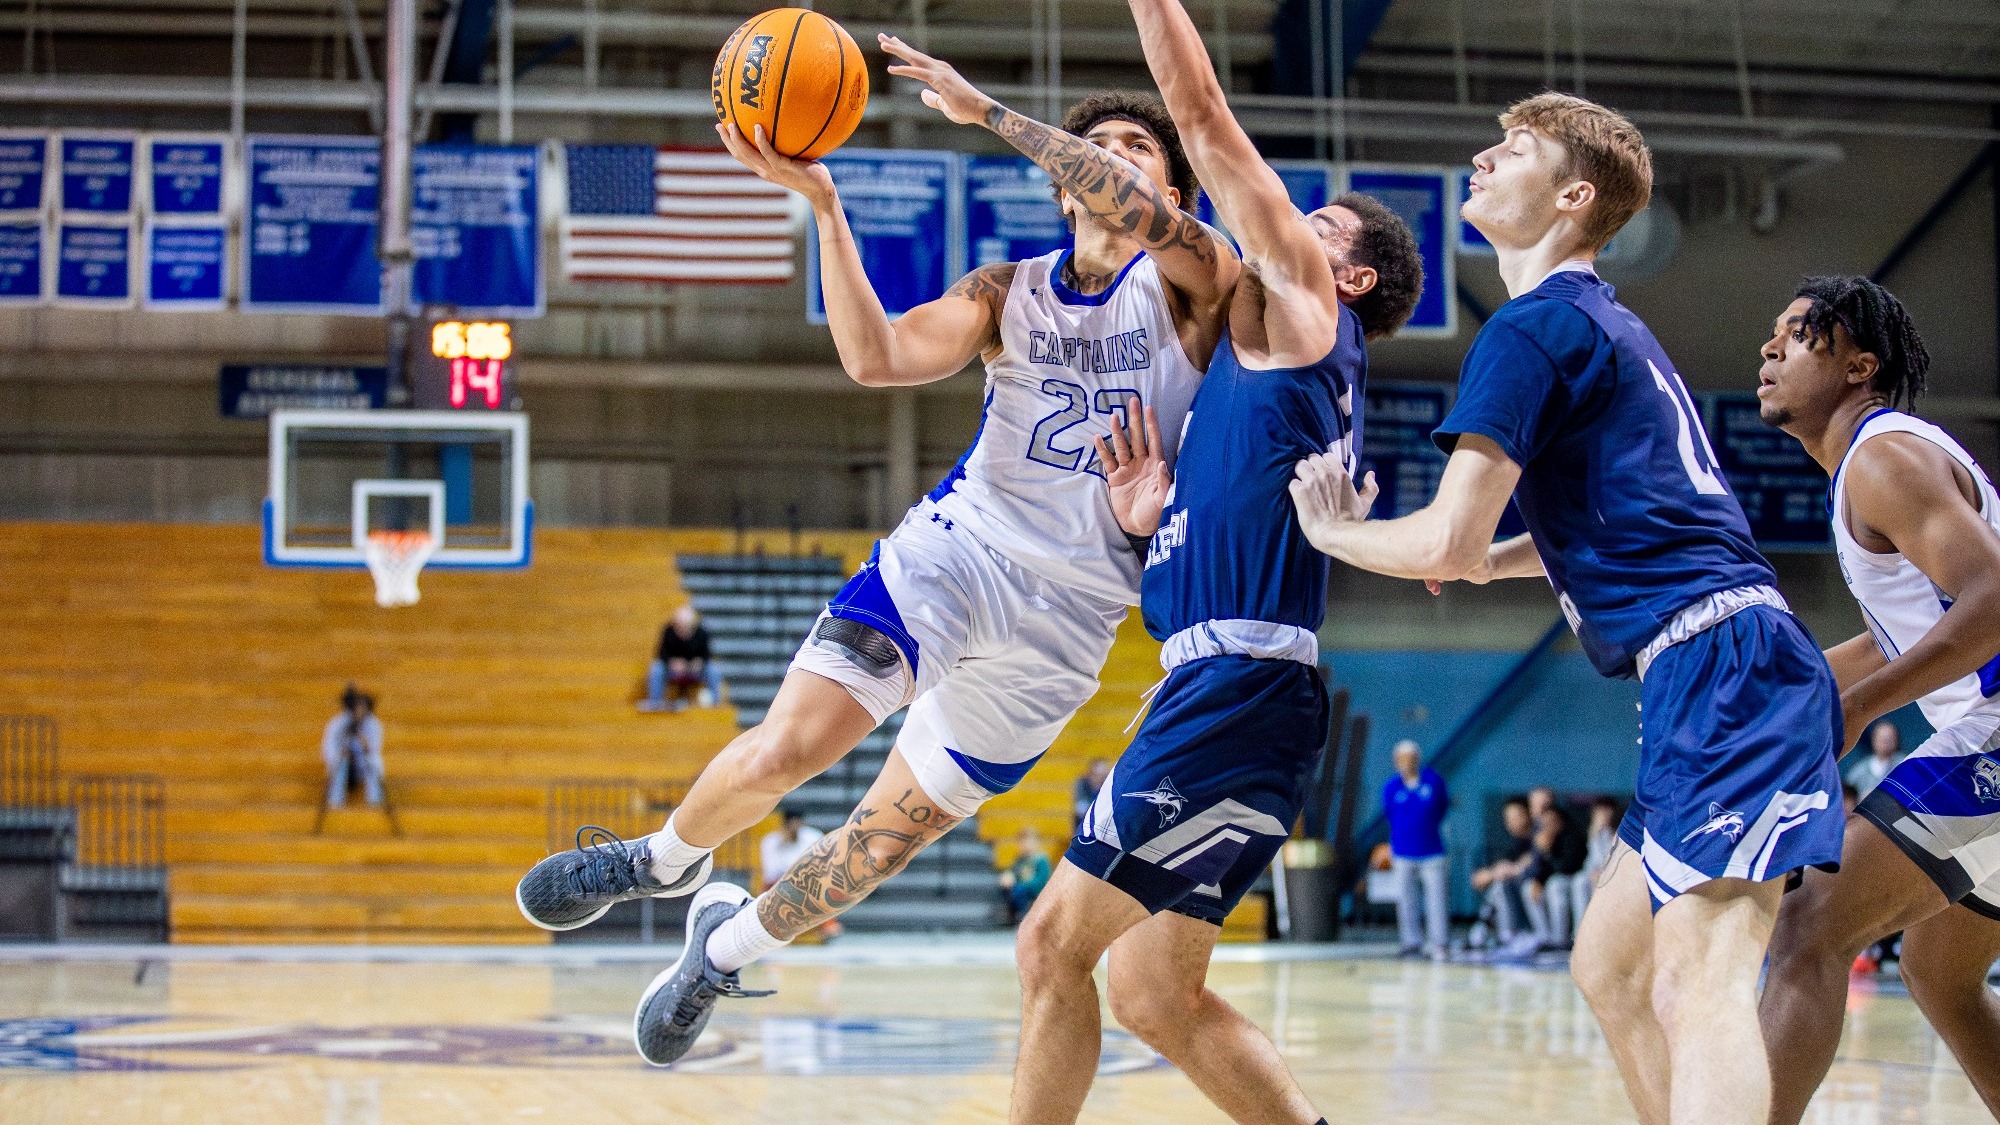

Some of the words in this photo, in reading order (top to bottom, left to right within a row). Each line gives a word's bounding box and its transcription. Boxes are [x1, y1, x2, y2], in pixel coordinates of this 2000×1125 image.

[740, 34, 774, 110] NCAA
[1029, 327, 1151, 374] CAPTAINS
[450, 357, 502, 409] 14
